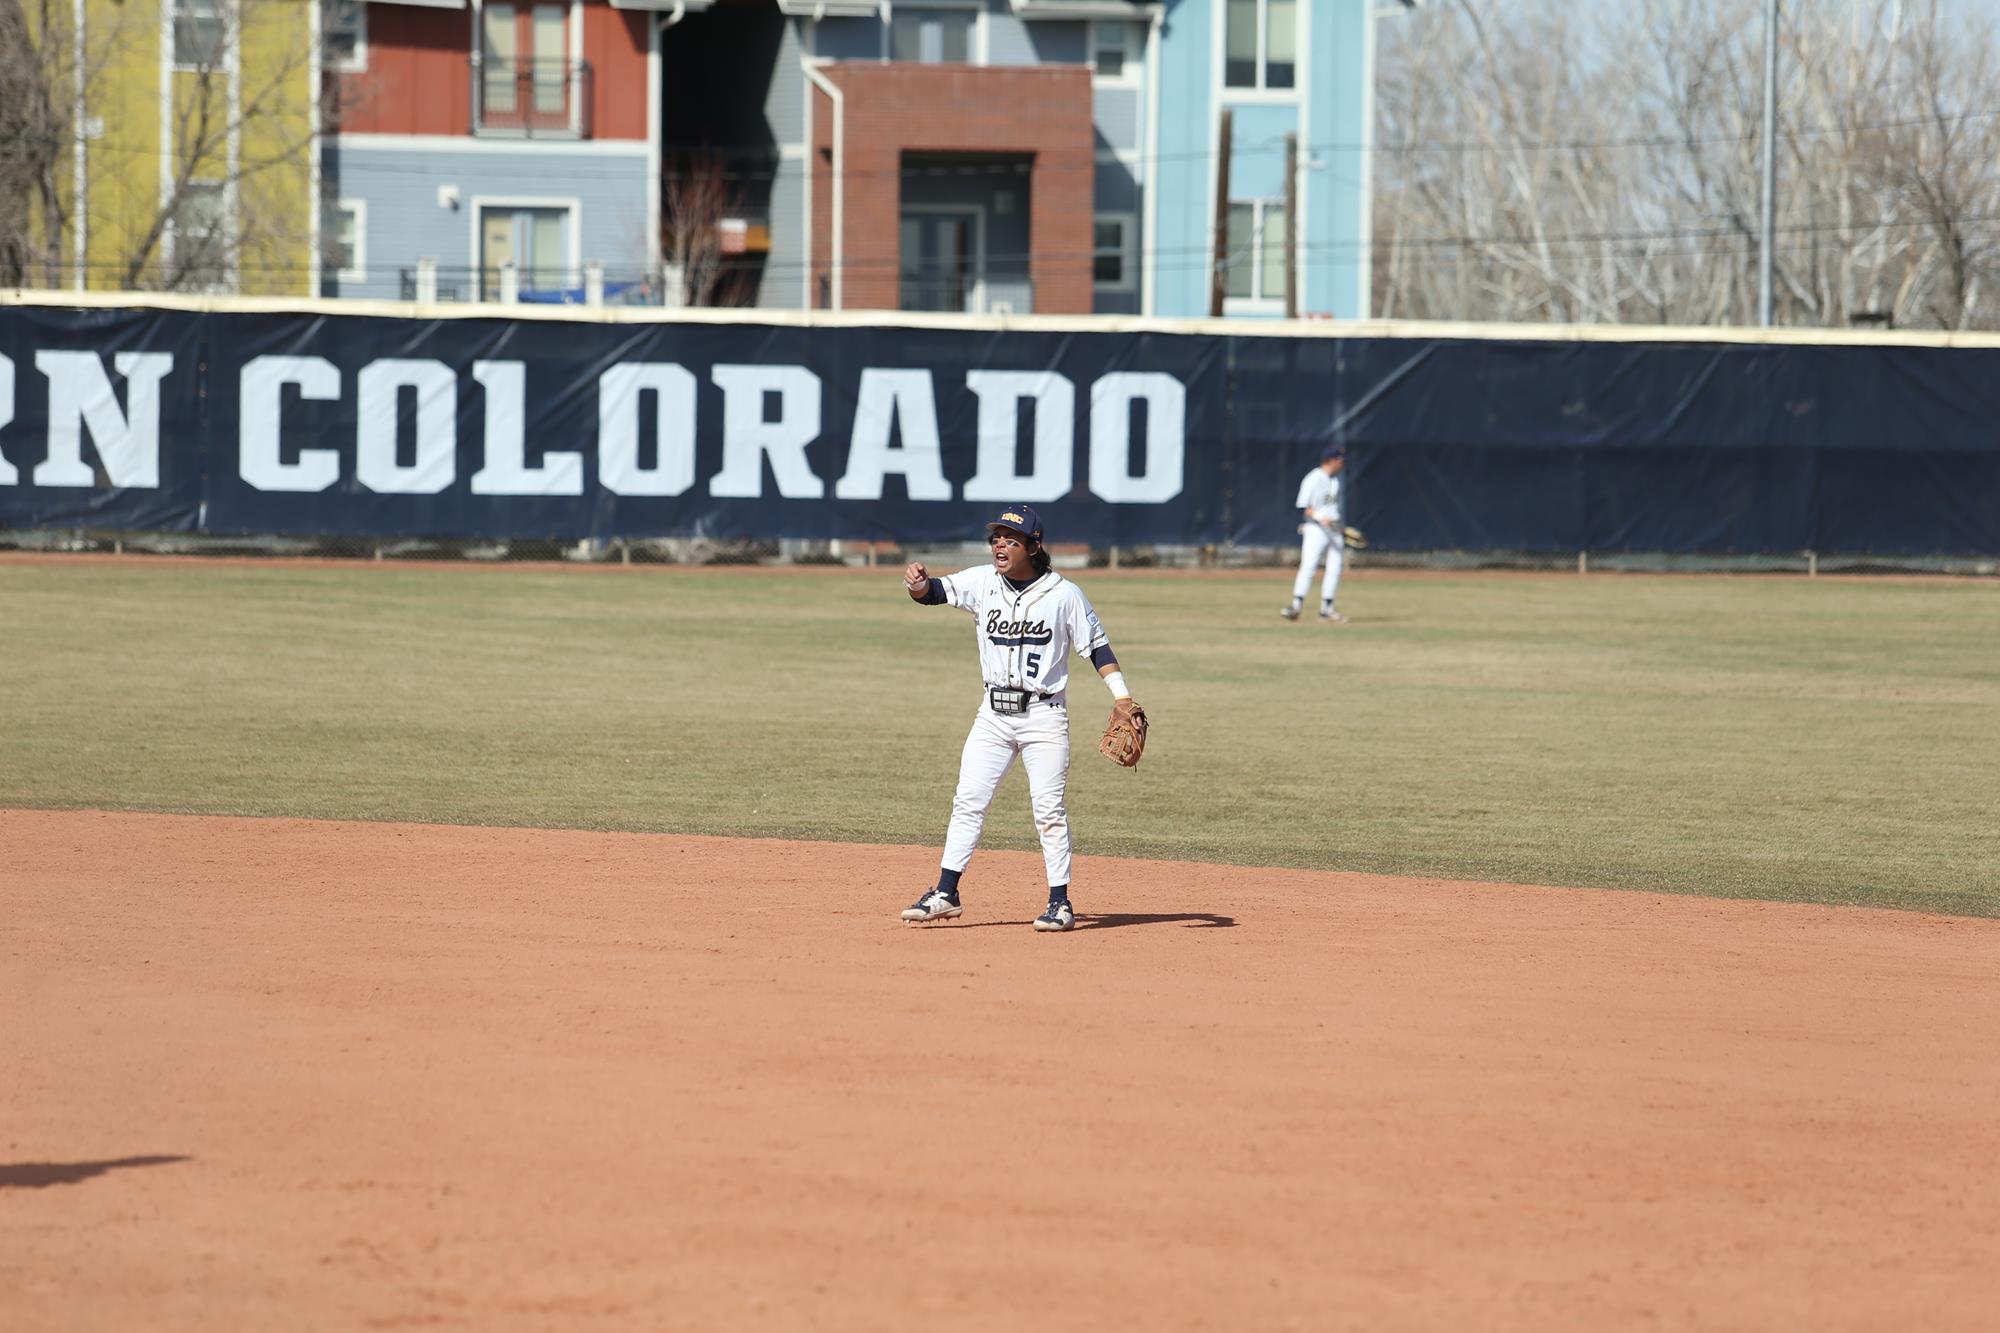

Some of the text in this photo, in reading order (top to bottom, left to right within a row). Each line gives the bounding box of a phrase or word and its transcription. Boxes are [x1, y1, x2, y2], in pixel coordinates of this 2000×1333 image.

[0, 350, 1186, 503] N COLORADO
[986, 609, 1052, 638] Bears
[1026, 652, 1041, 679] 5
